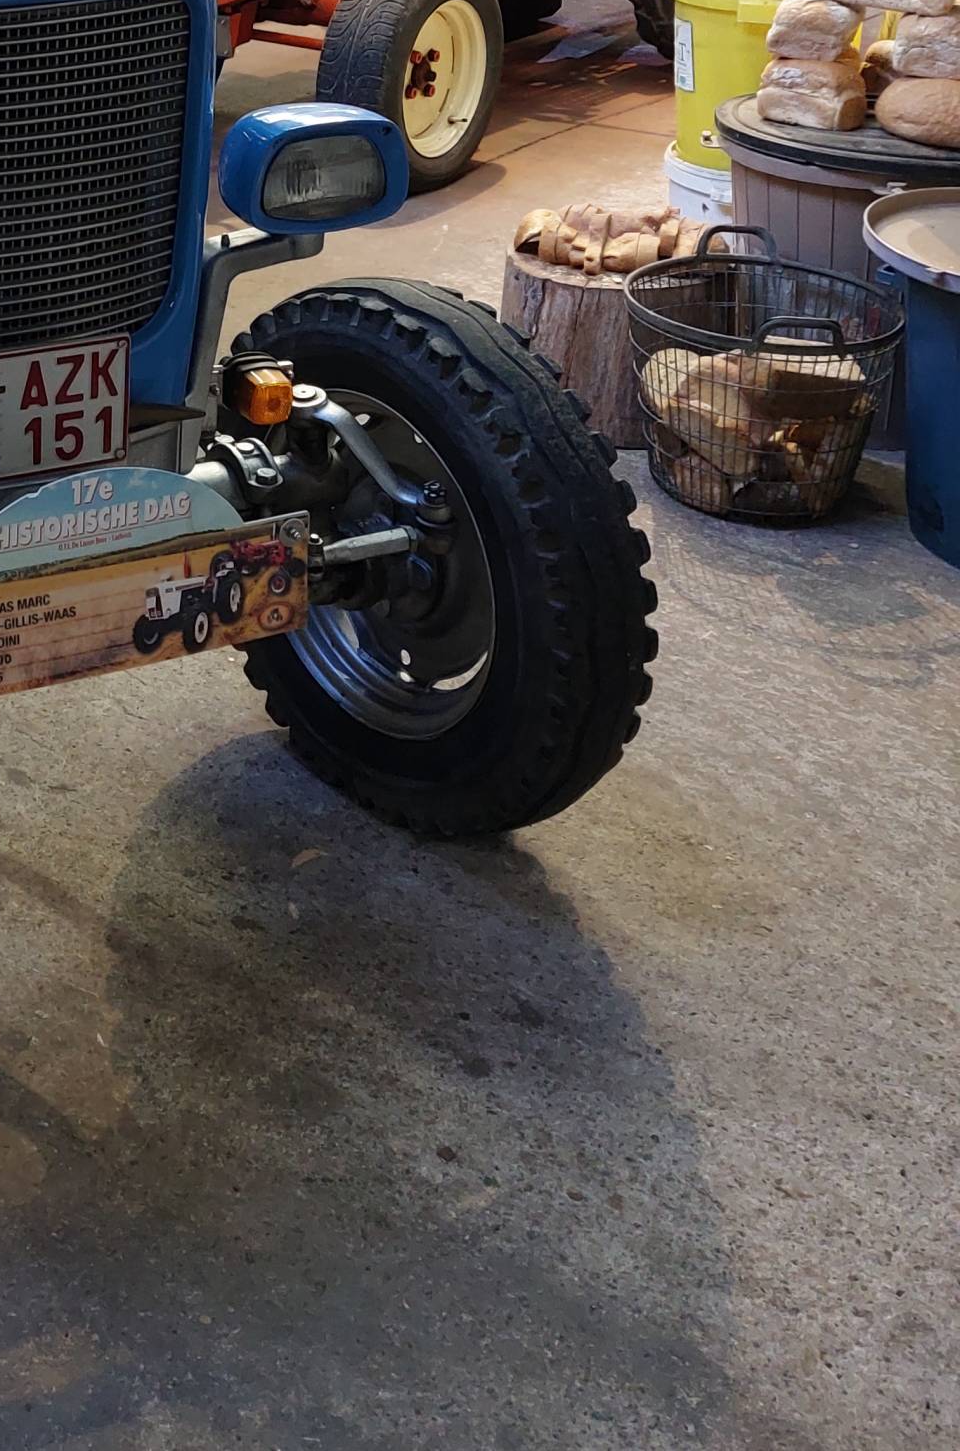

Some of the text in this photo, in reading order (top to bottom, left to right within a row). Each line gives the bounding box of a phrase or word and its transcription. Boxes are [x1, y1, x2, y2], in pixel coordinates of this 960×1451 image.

[24, 405, 112, 466] 151
[71, 476, 114, 506] 17e
[144, 491, 191, 523] DAG
[0, 601, 15, 615] AS
[17, 594, 51, 610] MARC
